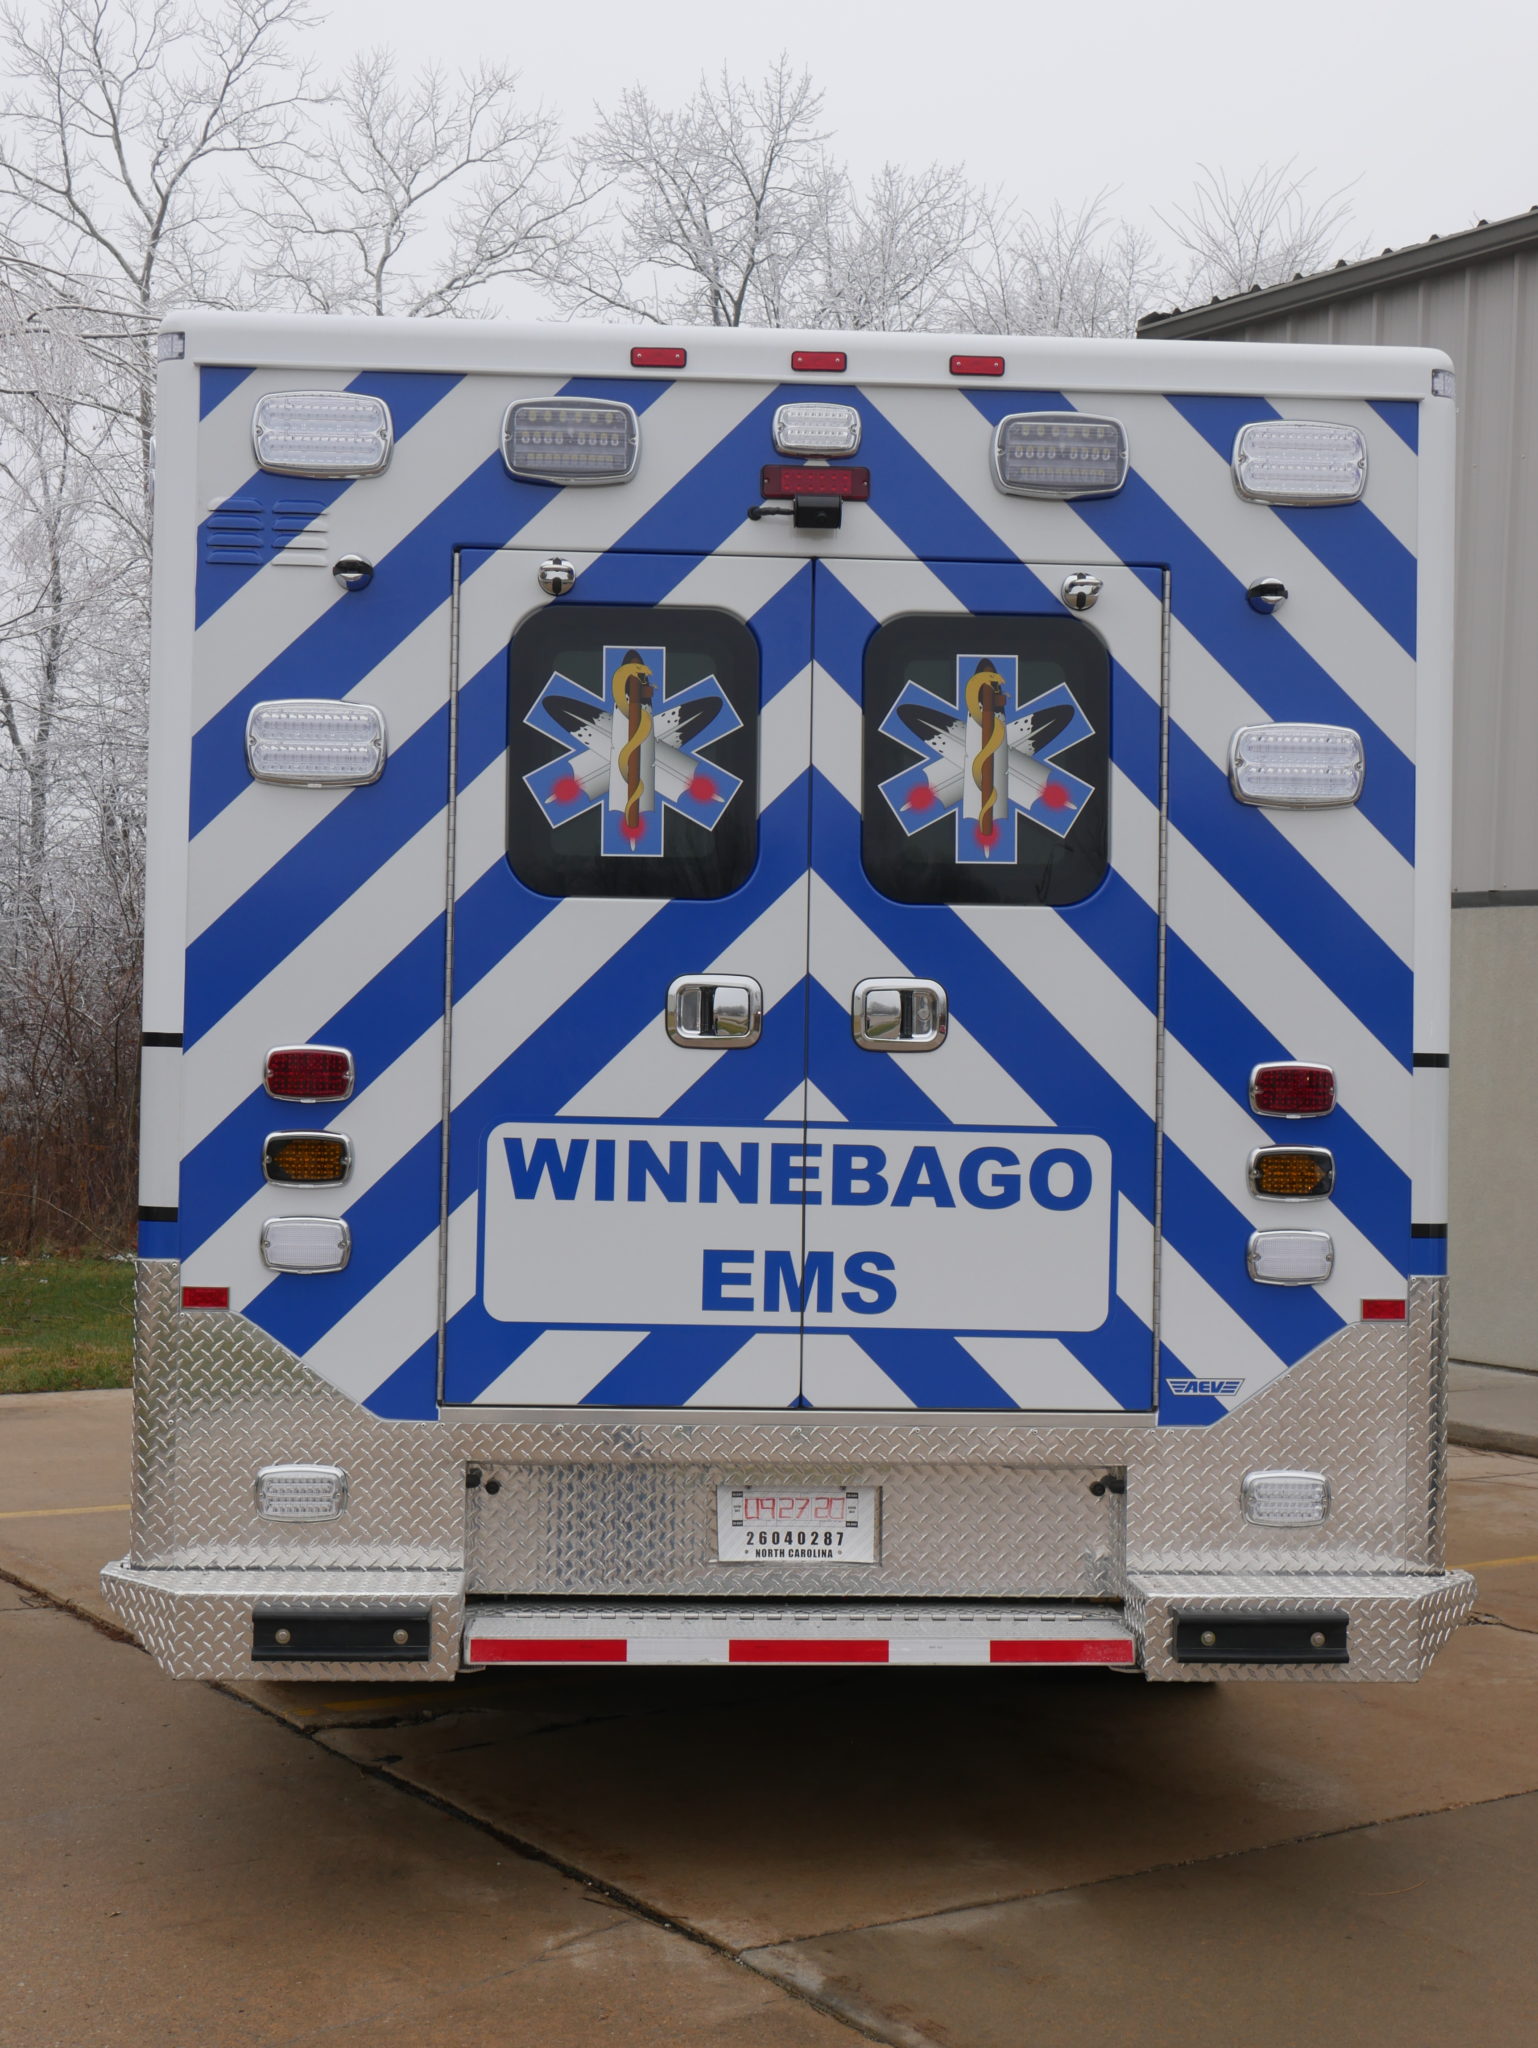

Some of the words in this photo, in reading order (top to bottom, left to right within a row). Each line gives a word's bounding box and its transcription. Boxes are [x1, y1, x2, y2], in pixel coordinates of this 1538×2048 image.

[503, 1136, 1094, 1212] WINNEBAGO
[701, 1248, 898, 1315] EMS
[1183, 1380, 1226, 1394] AEV
[746, 1531, 844, 1546] 26040287
[755, 1548, 785, 1558] NORTH
[788, 1548, 833, 1558] CAROLINA
